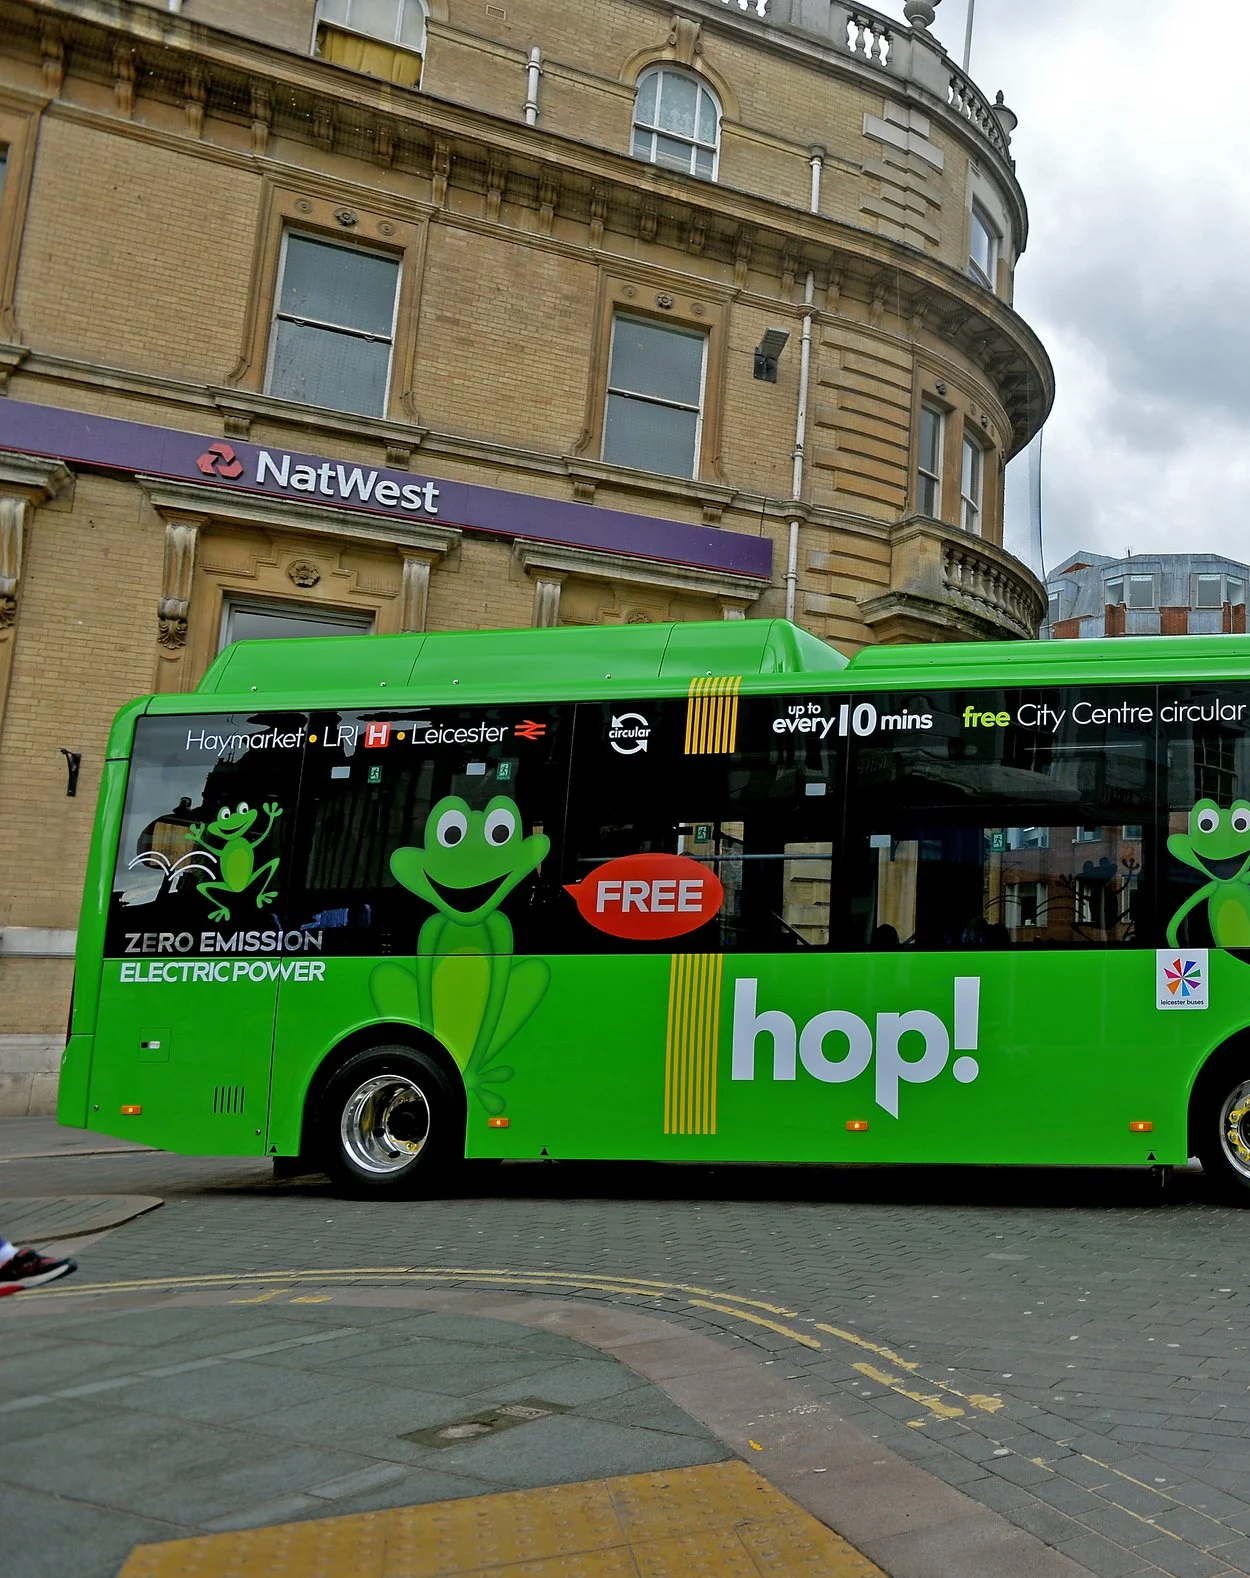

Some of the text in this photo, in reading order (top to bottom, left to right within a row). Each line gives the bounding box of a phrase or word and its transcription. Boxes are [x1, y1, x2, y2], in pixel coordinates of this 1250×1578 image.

[255, 450, 440, 514] NatWest
[772, 702, 934, 740] every 10 mins
[787, 702, 822, 718] up to
[962, 698, 1247, 733] free City Centre circular
[185, 727, 305, 757] Haymarket
[322, 725, 359, 747] LRI
[411, 721, 509, 744] Leicester
[608, 726, 652, 739] circular
[595, 879, 704, 913] FREE
[124, 930, 324, 953] ZERO EMISSION
[119, 961, 326, 983] ELECTRIC POWER
[731, 976, 981, 1120] hop!
